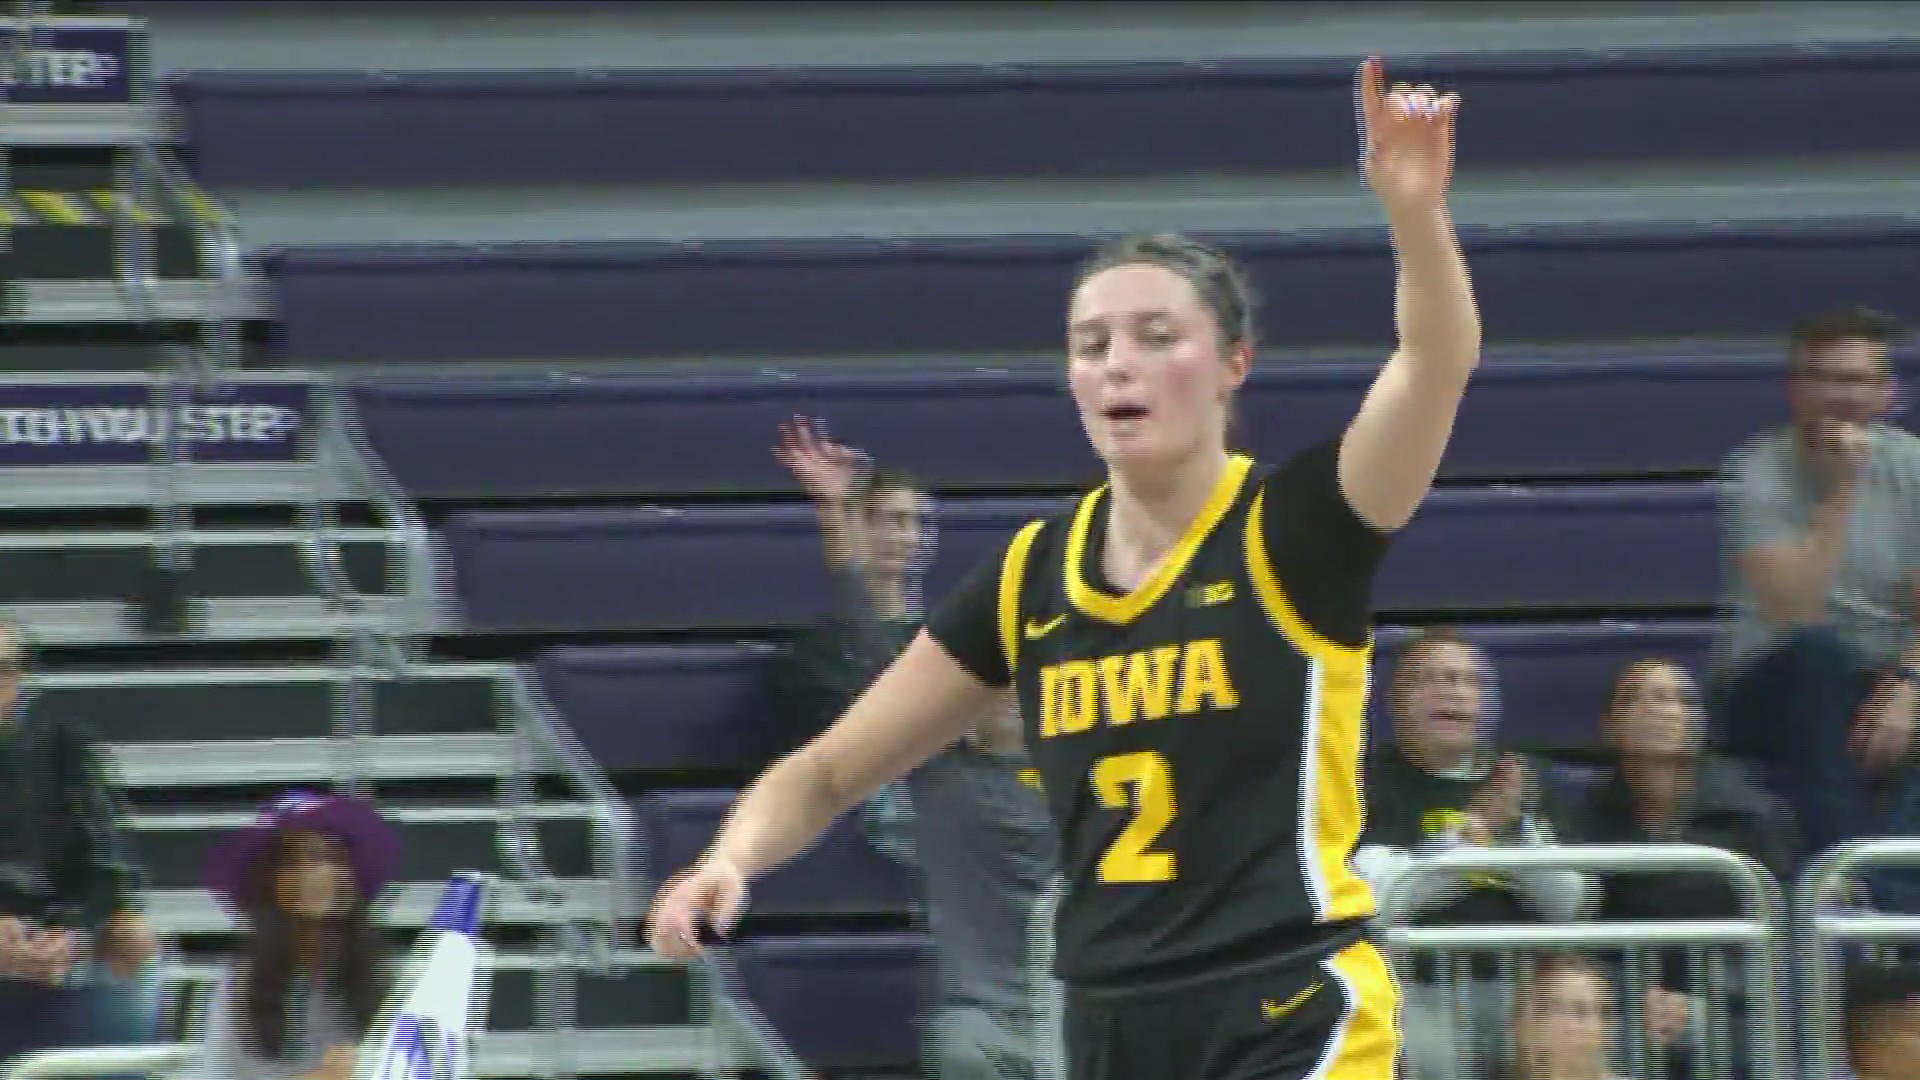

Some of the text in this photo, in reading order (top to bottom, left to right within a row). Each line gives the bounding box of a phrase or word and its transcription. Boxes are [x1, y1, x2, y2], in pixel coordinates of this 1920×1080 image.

[175, 404, 300, 441] STEP
[1040, 638, 1240, 738] IOWA
[1090, 751, 1178, 884] 2
